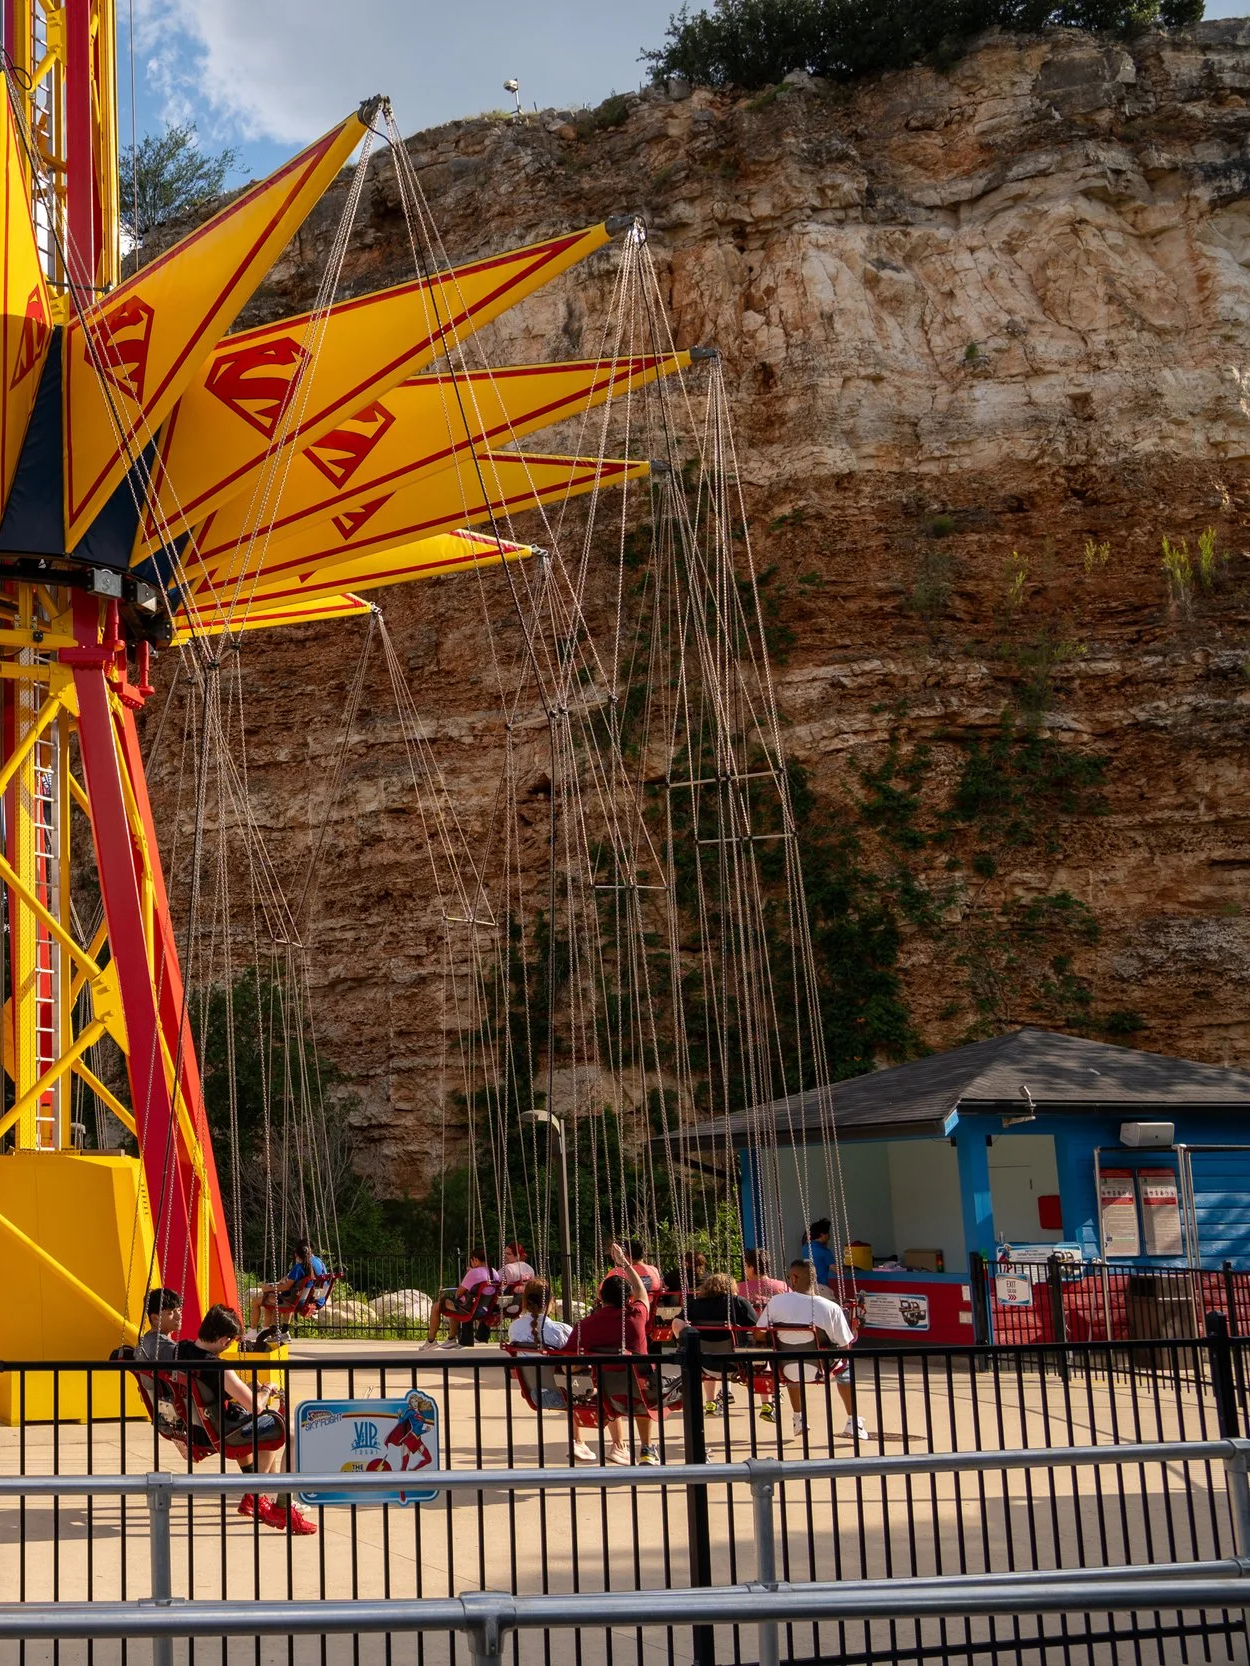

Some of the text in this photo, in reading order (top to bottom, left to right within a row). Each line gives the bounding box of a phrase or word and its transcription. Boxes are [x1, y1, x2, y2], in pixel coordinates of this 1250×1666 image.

[1006, 1280, 1016, 1288] EXIT
[353, 1421, 378, 1446] VIP
[352, 1463, 363, 1471] THE
